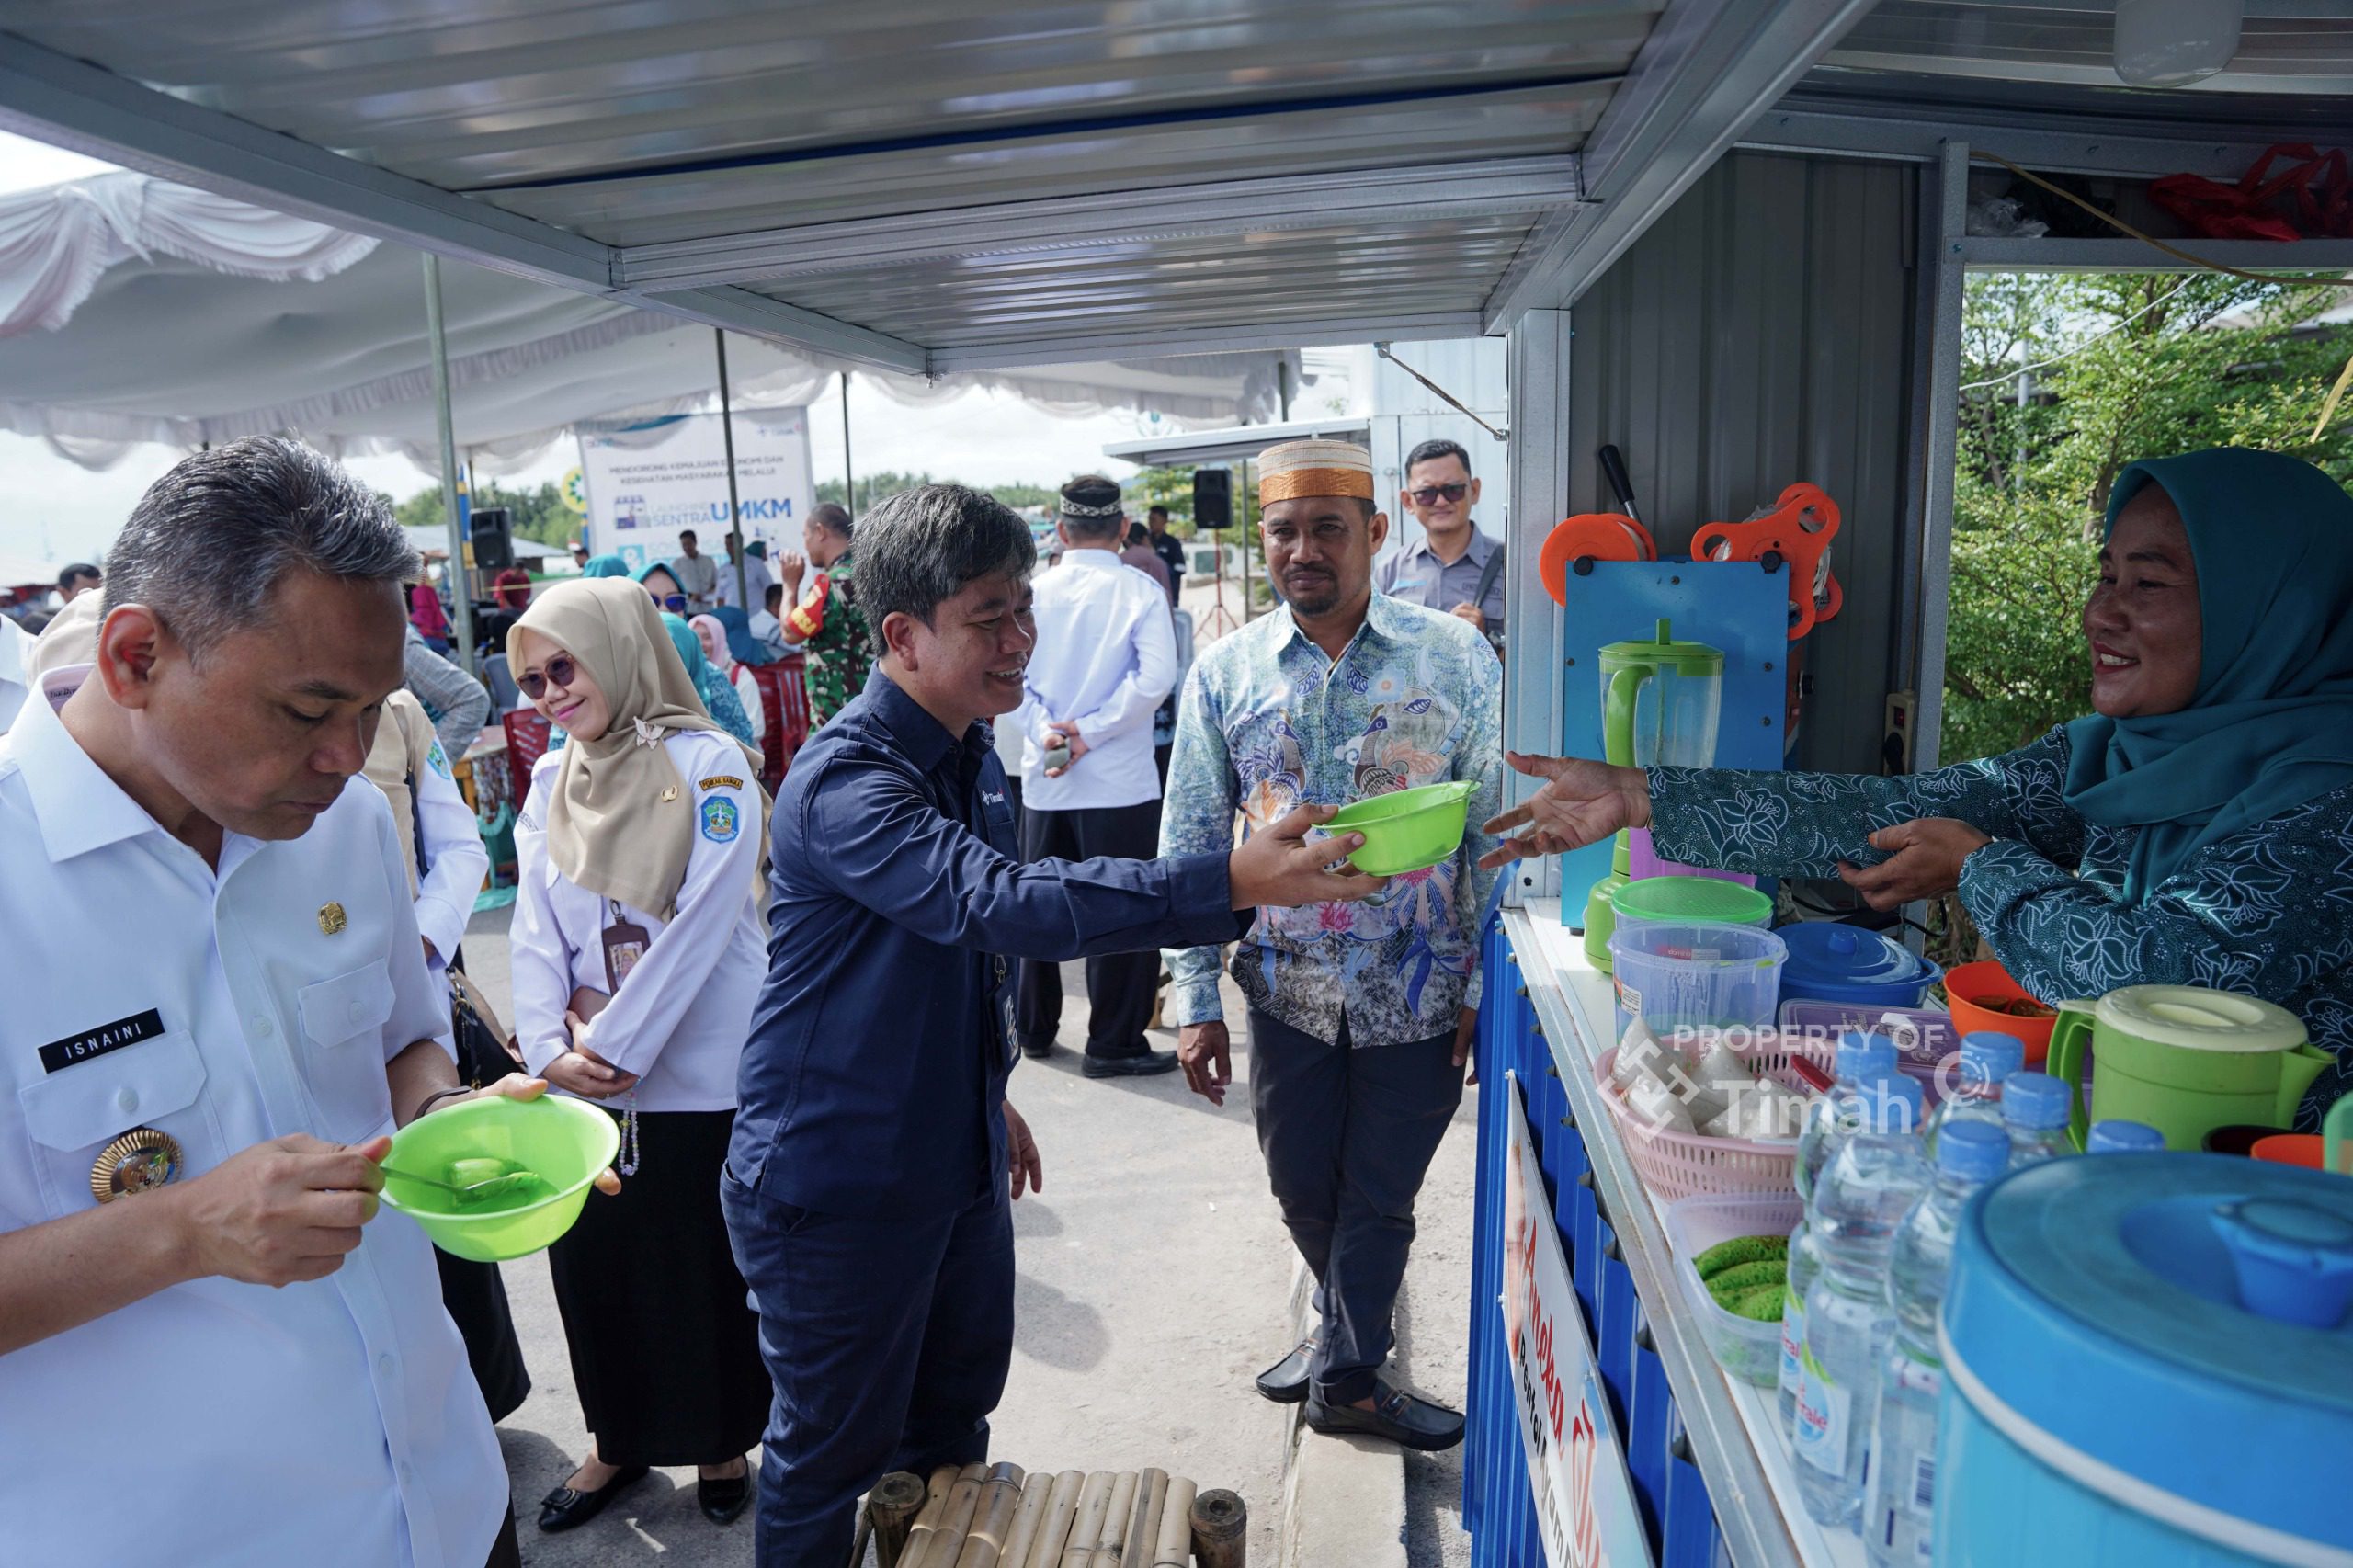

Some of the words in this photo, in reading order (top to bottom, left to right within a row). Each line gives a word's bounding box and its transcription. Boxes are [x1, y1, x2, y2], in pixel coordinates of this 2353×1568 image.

[653, 511, 711, 528] SENTRA
[65, 1022, 142, 1059] ISNAINI
[1519, 1332, 1542, 1454] Pentol
[1539, 1436, 1564, 1562] Ayam
